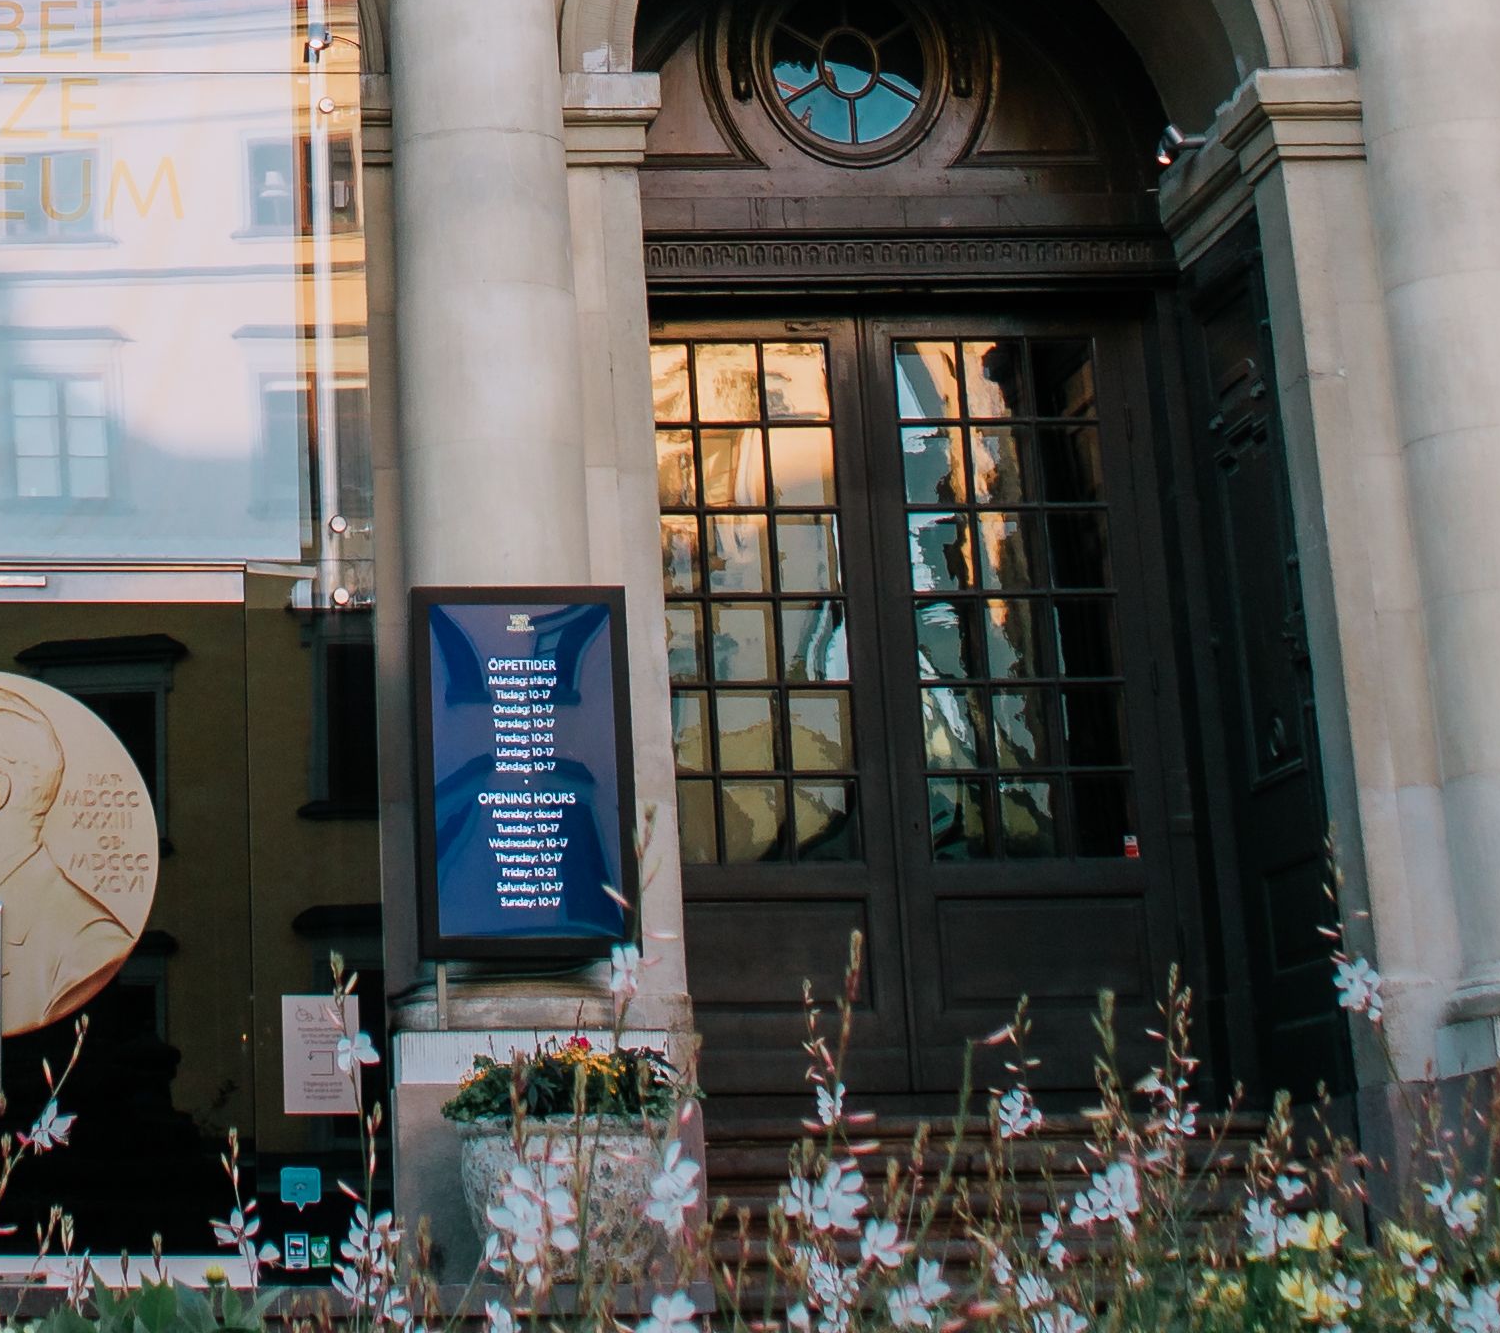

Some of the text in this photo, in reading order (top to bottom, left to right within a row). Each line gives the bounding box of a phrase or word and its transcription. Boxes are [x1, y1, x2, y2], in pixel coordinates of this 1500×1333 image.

[488, 658, 557, 671] ÖPPETTIDER
[495, 690, 551, 701] Tisdag: 10-17
[493, 704, 555, 715] Onsdag: 10-17
[493, 718, 555, 730] Torsdag: 10-17
[495, 733, 554, 744] Fredag: 10-21
[496, 747, 555, 758] Lördag: 10-17
[495, 762, 556, 773] Söndag: 10-17
[62, 789, 140, 808] MDCCC
[478, 792, 576, 804] OPENING HOURS
[492, 809, 563, 820] Monday: closed
[496, 824, 560, 834] Tuesday: 10-17
[488, 838, 568, 849] Wednesday: 10-17
[69, 853, 150, 871] MDCCC
[495, 853, 563, 864] Thursday: 10-17
[502, 867, 557, 878] Friday: 10-21
[93, 875, 145, 893] XCVI
[496, 882, 564, 893] Saturday: 10-17
[501, 897, 561, 908] Sunday: 10-17
